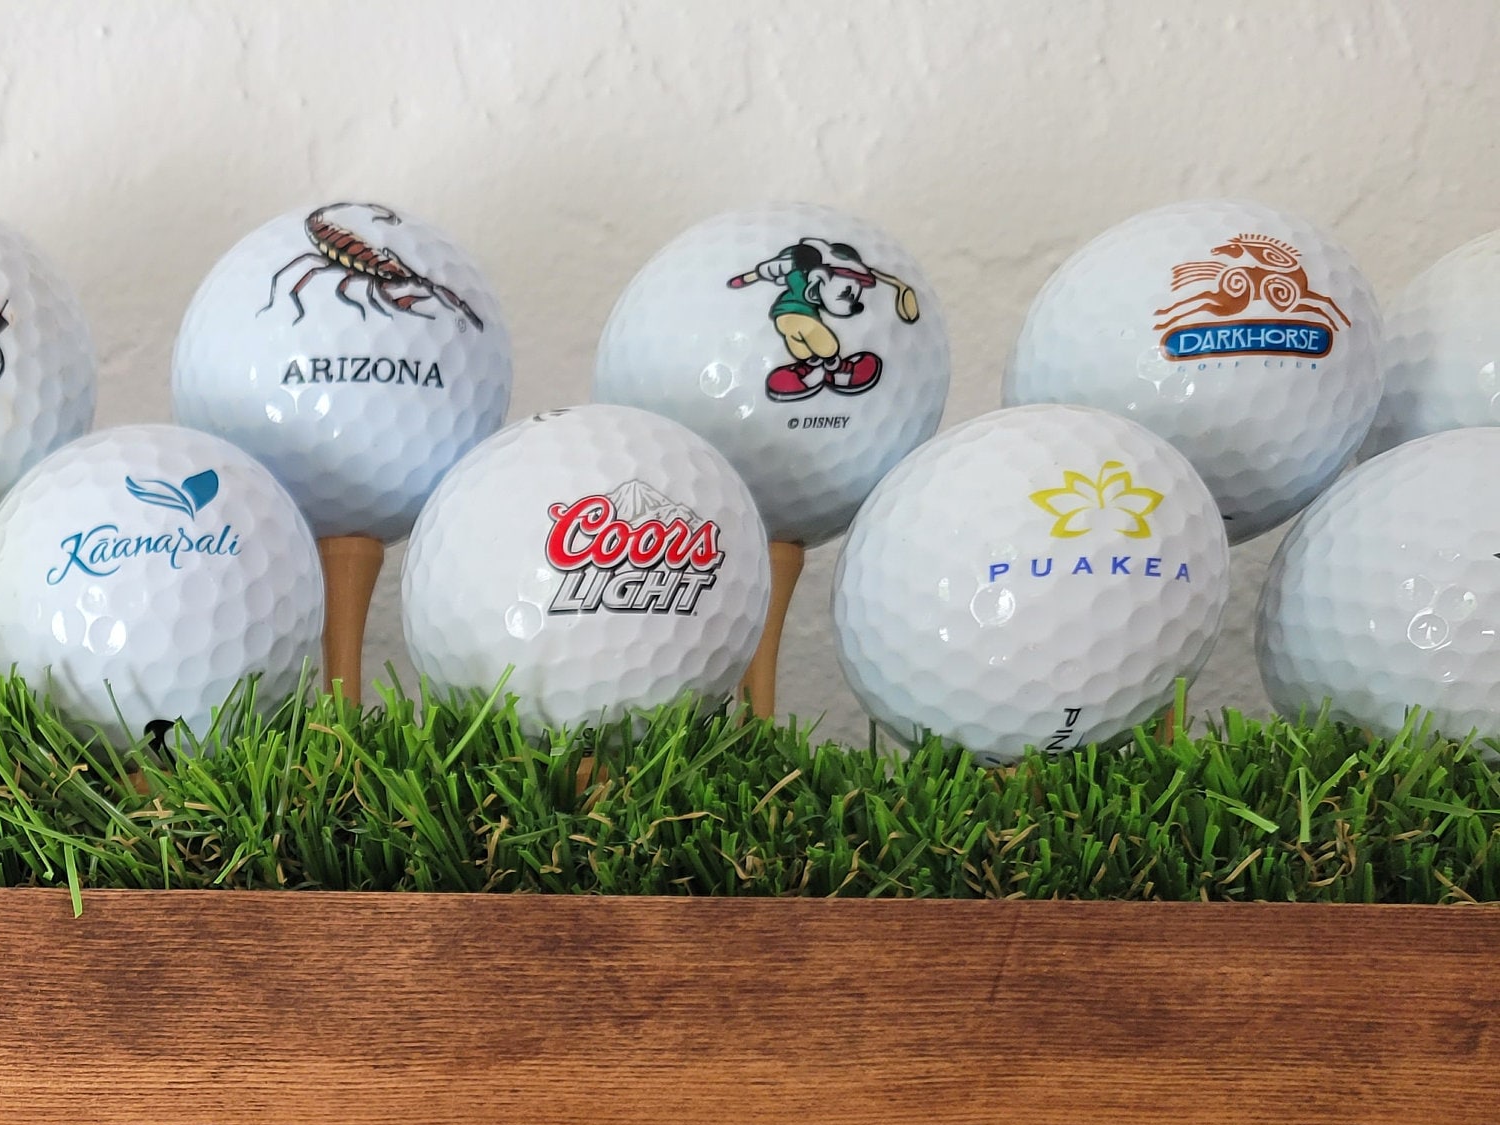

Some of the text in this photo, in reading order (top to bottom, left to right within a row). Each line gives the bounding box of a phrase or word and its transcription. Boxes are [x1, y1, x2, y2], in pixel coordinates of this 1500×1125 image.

[1178, 328, 1321, 354] DARKHORSE
[281, 356, 444, 389] ARIZONA
[802, 416, 850, 429] DISNEY
[546, 494, 725, 572] Coors
[988, 556, 1192, 583] PUAKEA
[547, 568, 717, 616] LIGHT
[1045, 707, 1083, 760] PIN
